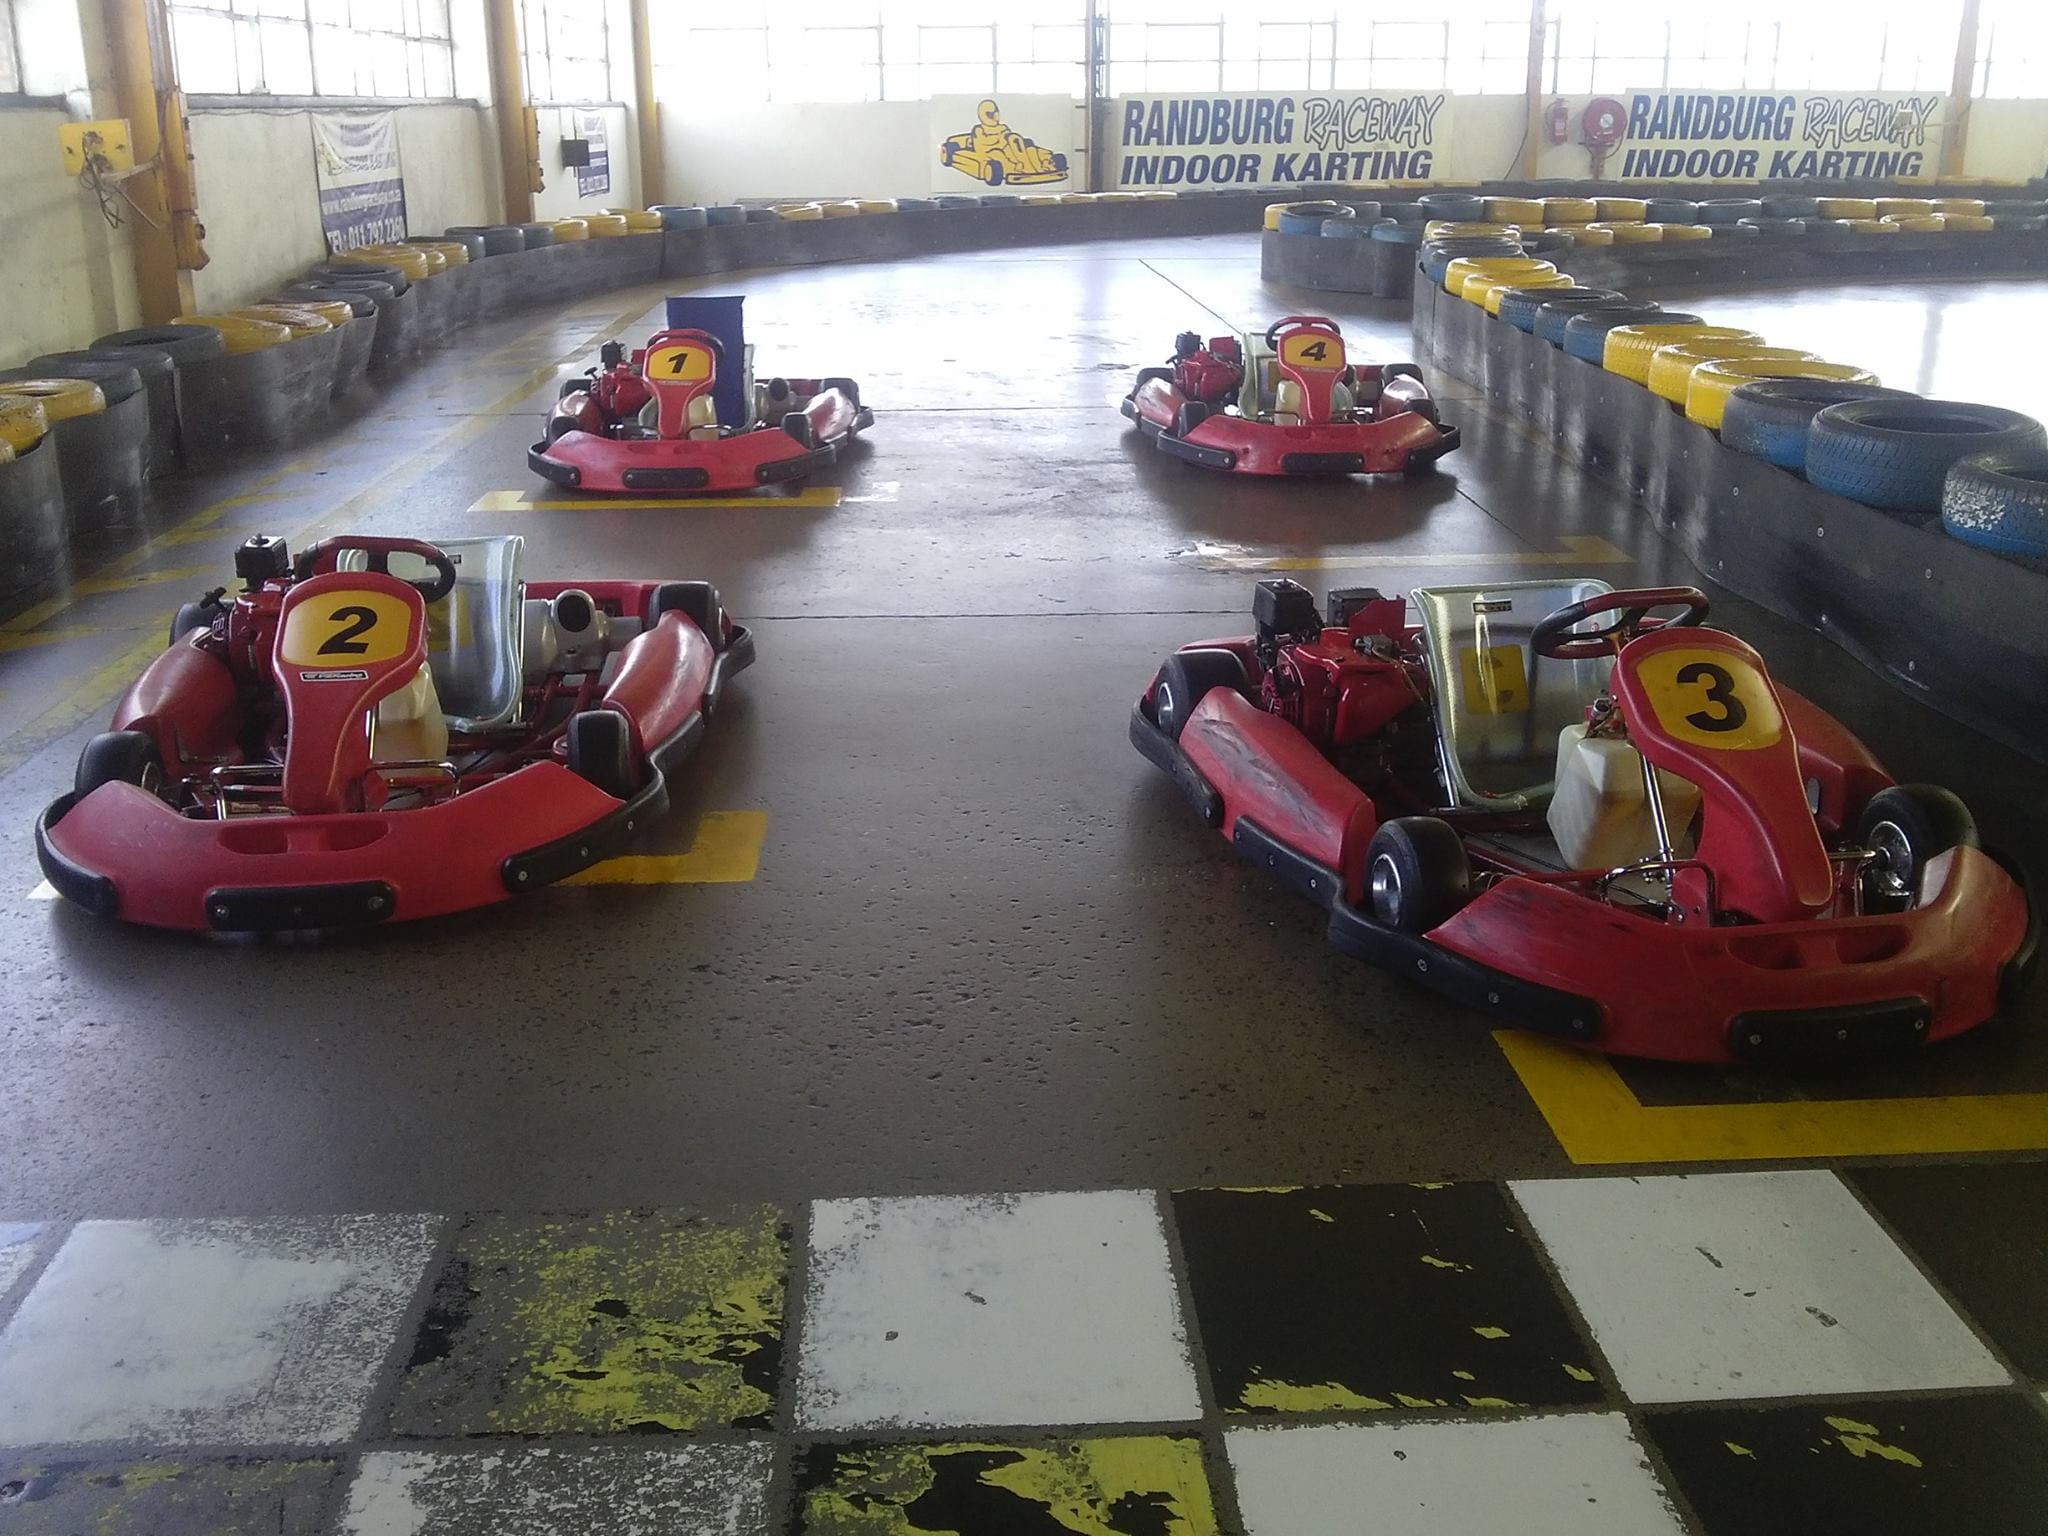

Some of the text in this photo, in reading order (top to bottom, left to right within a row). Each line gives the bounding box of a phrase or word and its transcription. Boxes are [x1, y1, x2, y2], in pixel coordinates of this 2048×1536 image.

[1122, 95, 1444, 150] RANDBURG RACEWAY
[1626, 95, 1937, 149] RANDBURG RACEWAY
[1120, 150, 1433, 185] INDOOR KARTING
[1621, 149, 1923, 178] INDOOR KARTING
[667, 353, 688, 374] 1
[1300, 341, 1327, 361] 4
[317, 606, 378, 655] 2
[1676, 662, 1747, 732] 3
